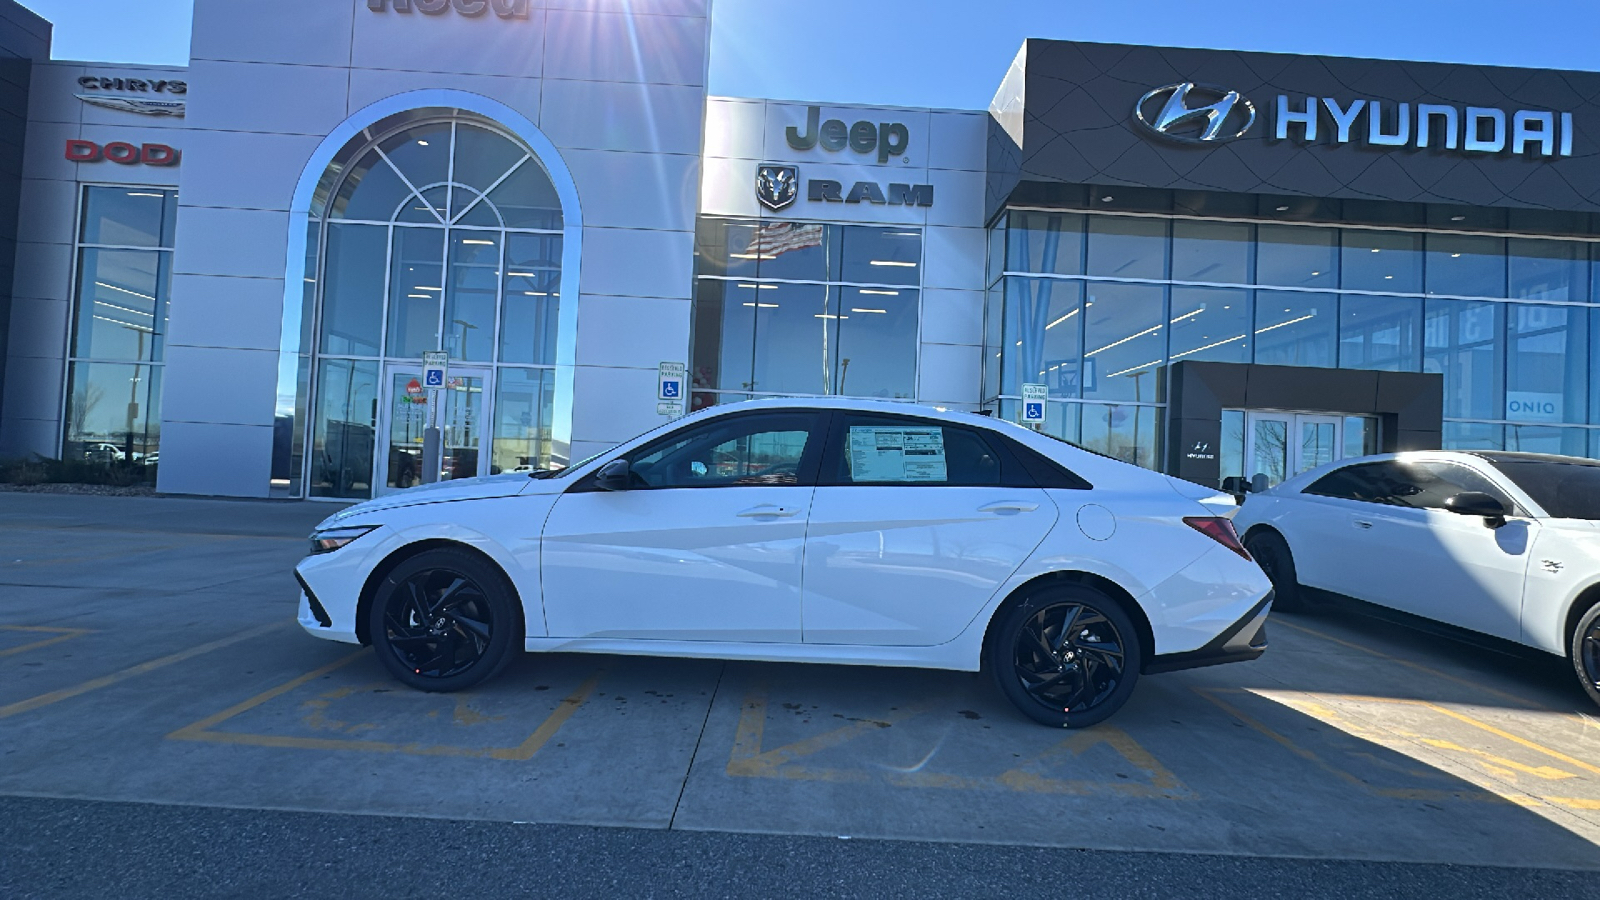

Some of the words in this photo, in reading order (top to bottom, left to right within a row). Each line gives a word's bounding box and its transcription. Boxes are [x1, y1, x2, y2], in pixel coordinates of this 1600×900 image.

[785, 106, 909, 163] Jeep
[1276, 94, 1573, 157] HYUNDAI
[65, 139, 182, 166] DOD
[807, 179, 934, 207] RAM
